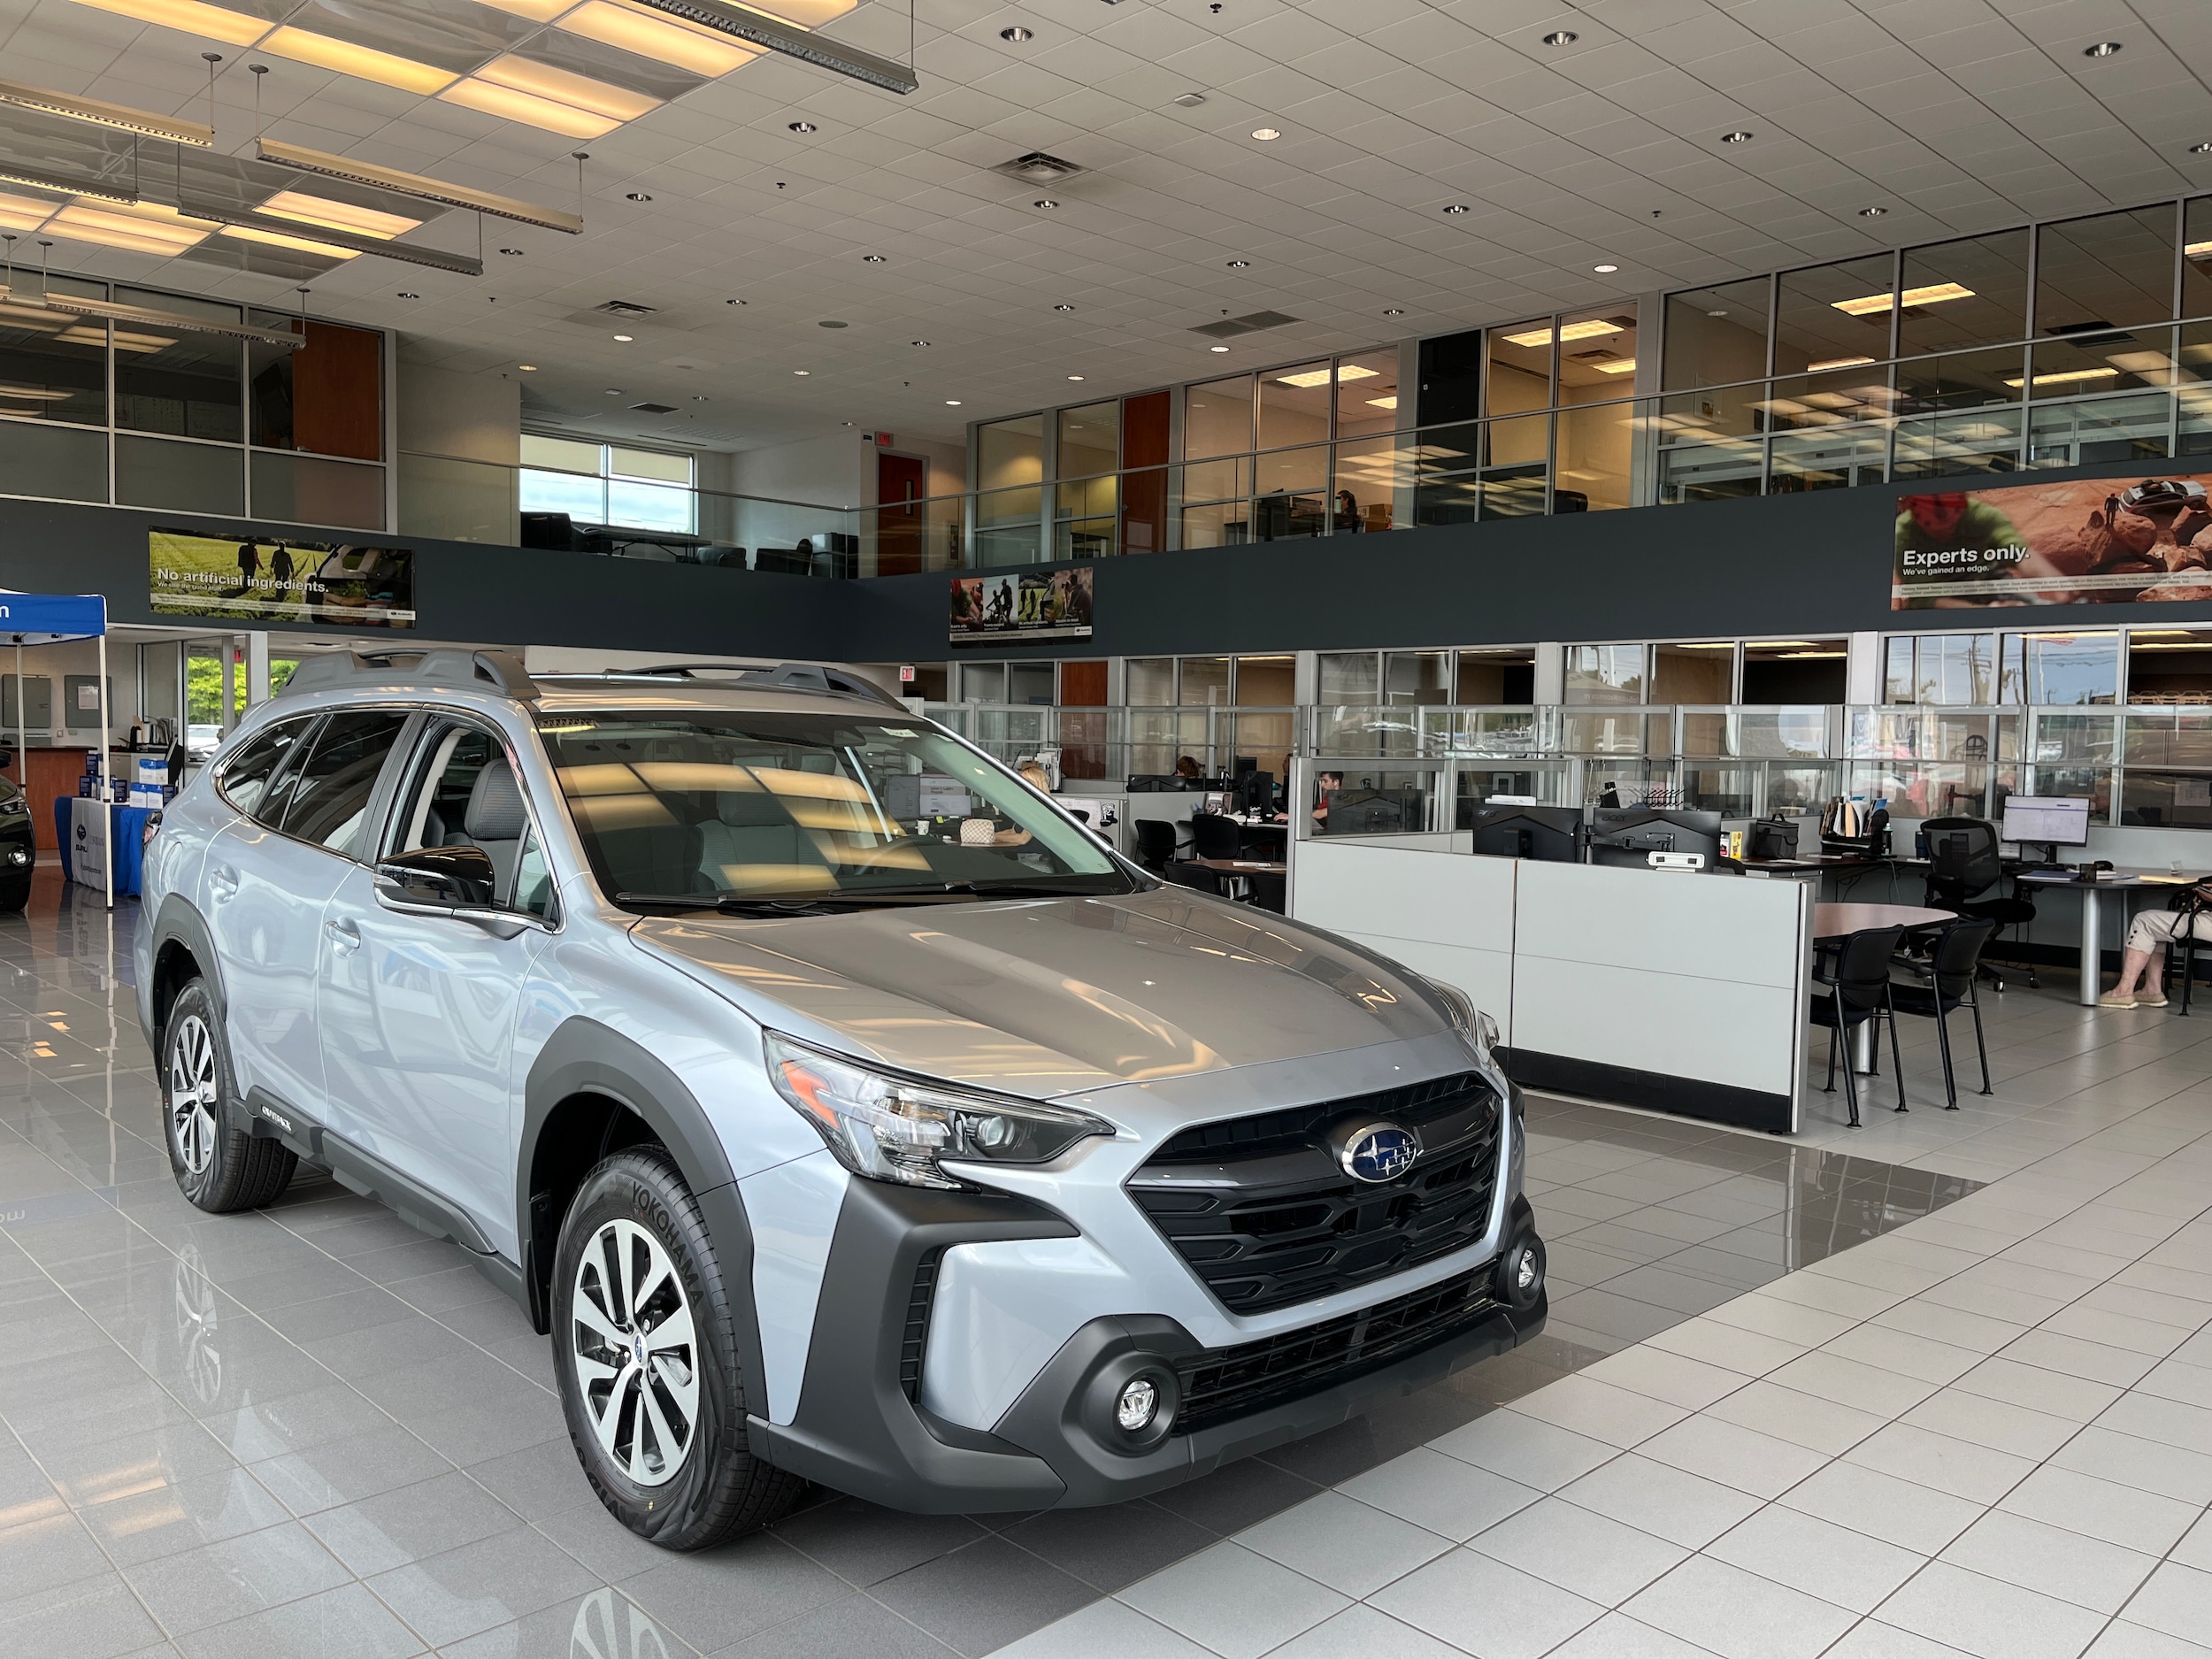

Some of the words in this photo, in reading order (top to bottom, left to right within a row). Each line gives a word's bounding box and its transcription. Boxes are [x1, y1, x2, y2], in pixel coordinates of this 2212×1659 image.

[1903, 548, 1978, 567] Experts
[1983, 543, 2030, 563] only.
[157, 568, 179, 580] No
[183, 572, 243, 587] artificial
[247, 575, 329, 594] ingredients.
[1902, 567, 1926, 576] We've
[1927, 566, 1954, 576] gained
[1967, 565, 1990, 573] edge.
[902, 667, 913, 680] EXIT
[1601, 813, 1629, 822] acer
[261, 1105, 292, 1132] OUTBACK
[632, 1180, 704, 1310] YOKOHAMA
